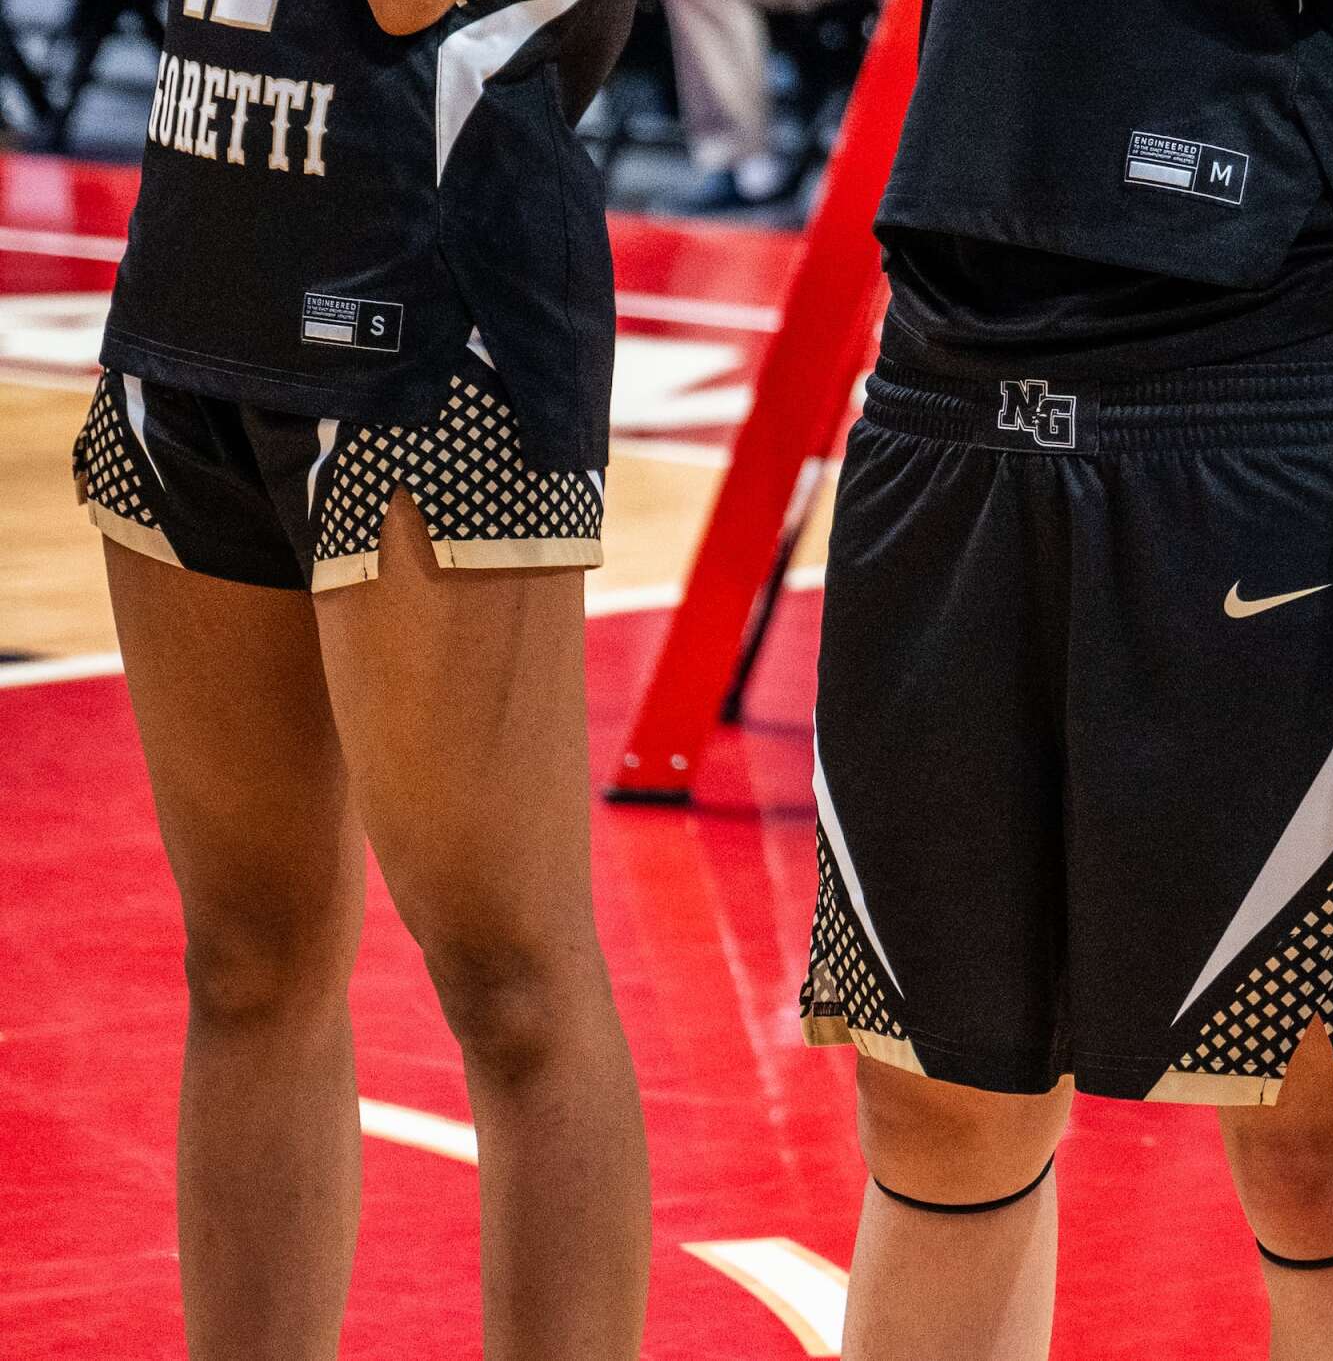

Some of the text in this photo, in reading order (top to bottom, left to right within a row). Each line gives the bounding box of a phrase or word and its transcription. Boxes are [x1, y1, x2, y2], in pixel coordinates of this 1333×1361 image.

[1134, 136, 1197, 155] ENGINEERED
[1209, 161, 1233, 187] M
[307, 297, 357, 311] ENGINEERED
[370, 315, 385, 336] S
[998, 379, 1077, 449] NG
